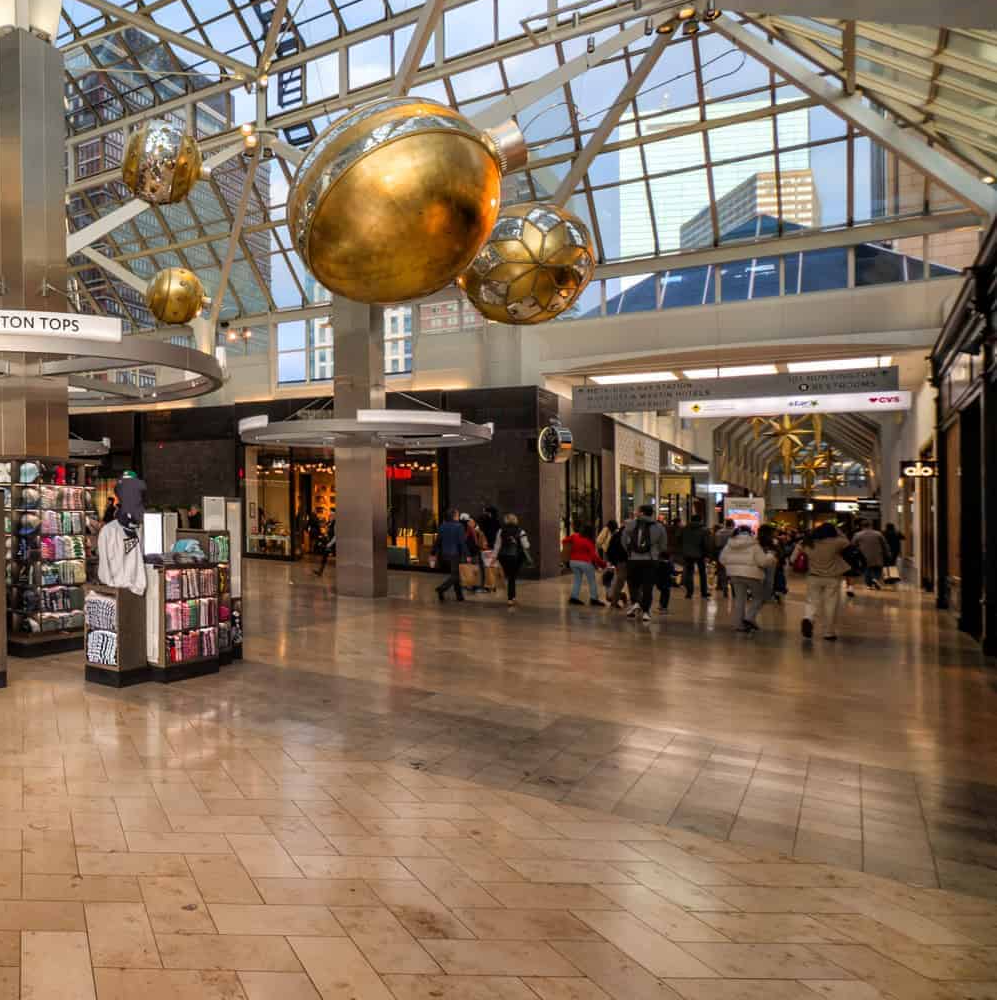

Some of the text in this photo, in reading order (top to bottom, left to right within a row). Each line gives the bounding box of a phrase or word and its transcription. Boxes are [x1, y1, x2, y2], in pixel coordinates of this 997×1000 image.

[39, 317, 79, 332] TOPS
[878, 396, 900, 404] CVS
[903, 462, 934, 476] alo
